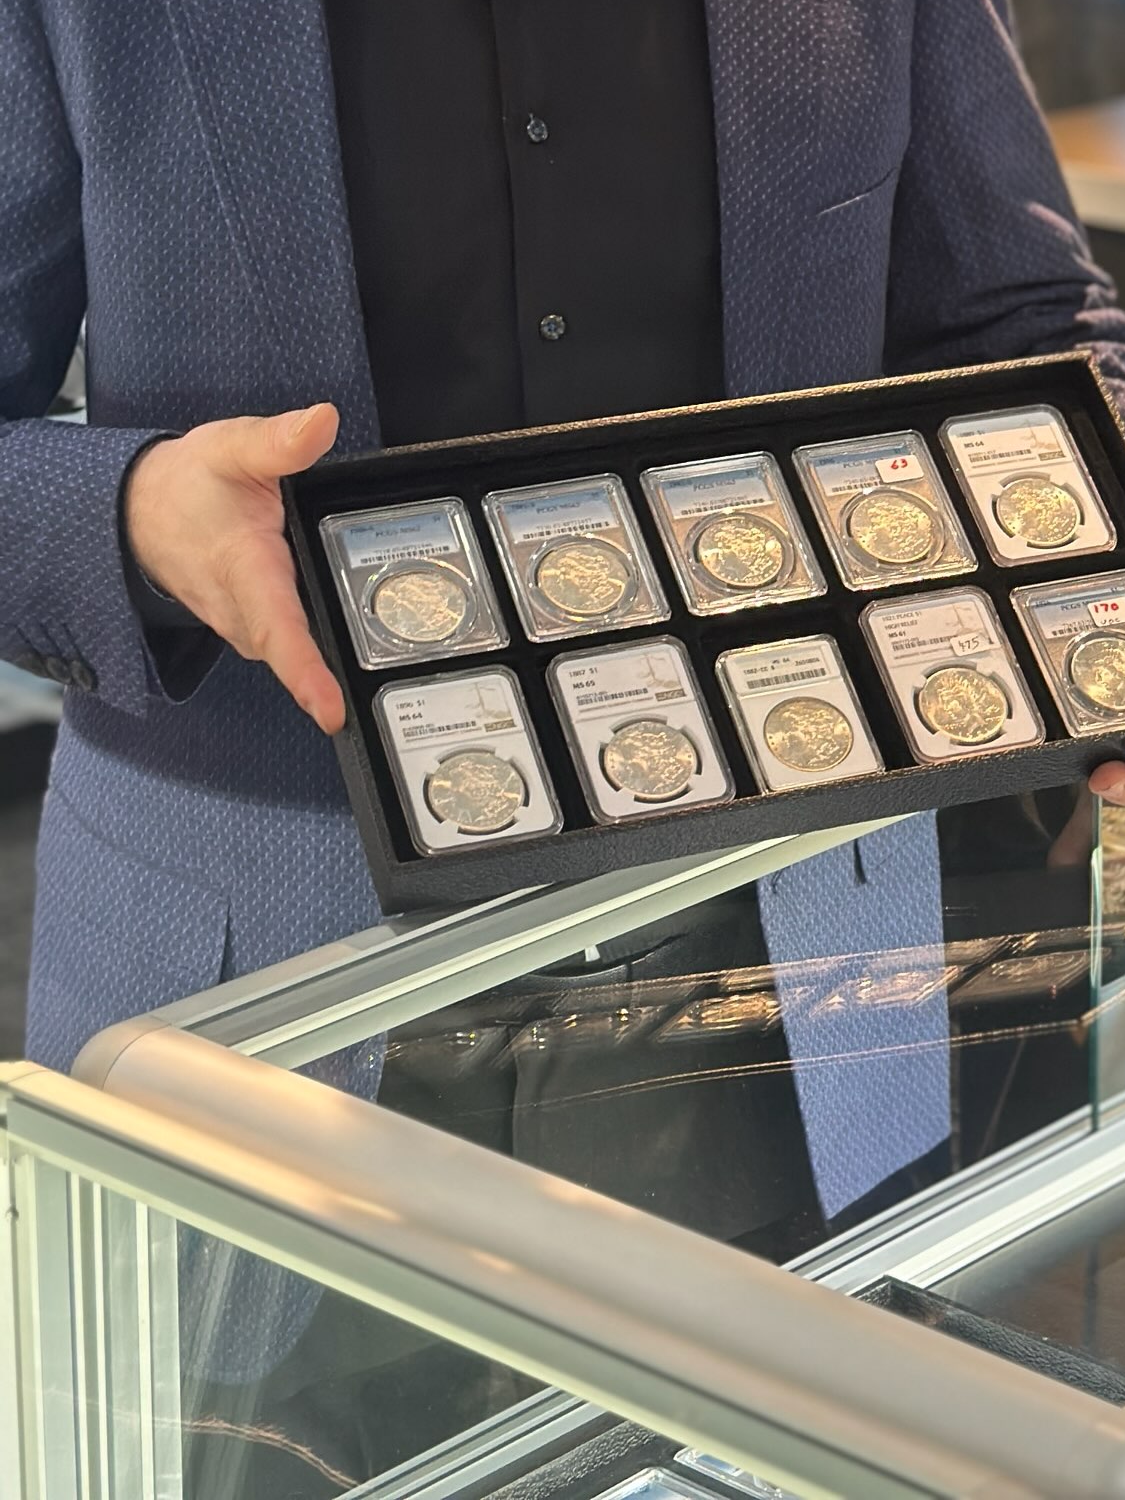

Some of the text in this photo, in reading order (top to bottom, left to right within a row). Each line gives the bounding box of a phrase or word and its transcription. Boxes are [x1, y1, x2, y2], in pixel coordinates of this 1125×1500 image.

[890, 458, 909, 470] 63
[1093, 602, 1120, 614] 170
[896, 612, 914, 621] PEACE
[900, 619, 918, 627] RELIEF
[958, 636, 980, 652] 475
[572, 680, 596, 690] MS 65
[398, 712, 423, 722] MS 64
